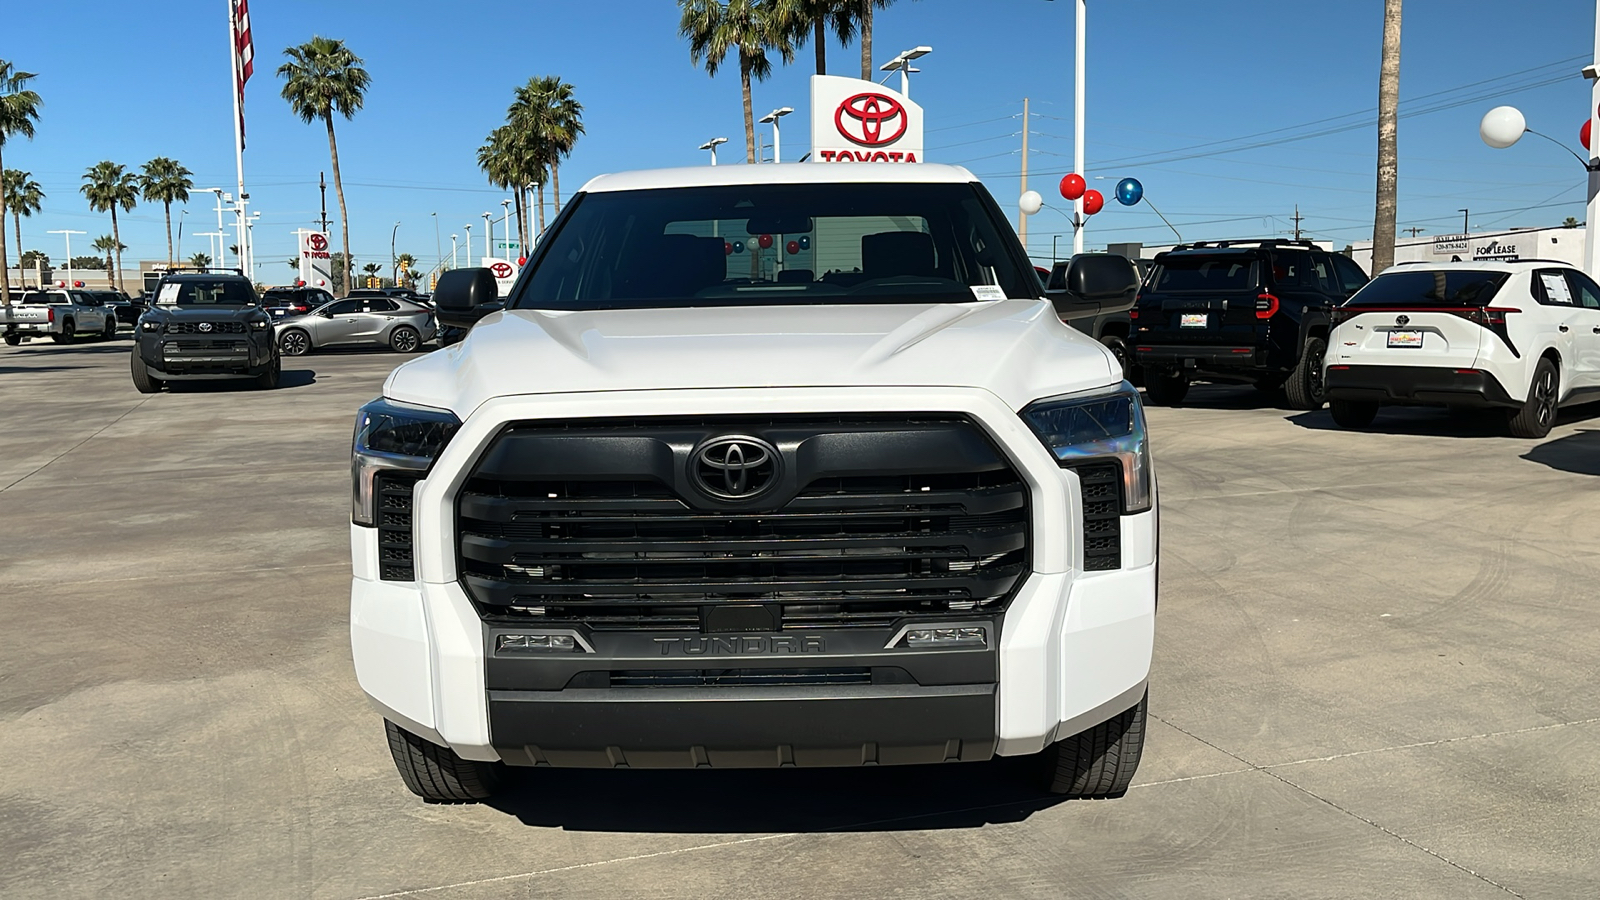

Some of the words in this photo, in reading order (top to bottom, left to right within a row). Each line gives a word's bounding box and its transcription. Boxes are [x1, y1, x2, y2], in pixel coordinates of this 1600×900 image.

[820, 150, 917, 163] TOYOTA
[1476, 246, 1491, 255] FOR
[1494, 245, 1516, 254] LEASE
[653, 636, 826, 656] TUNDRA
